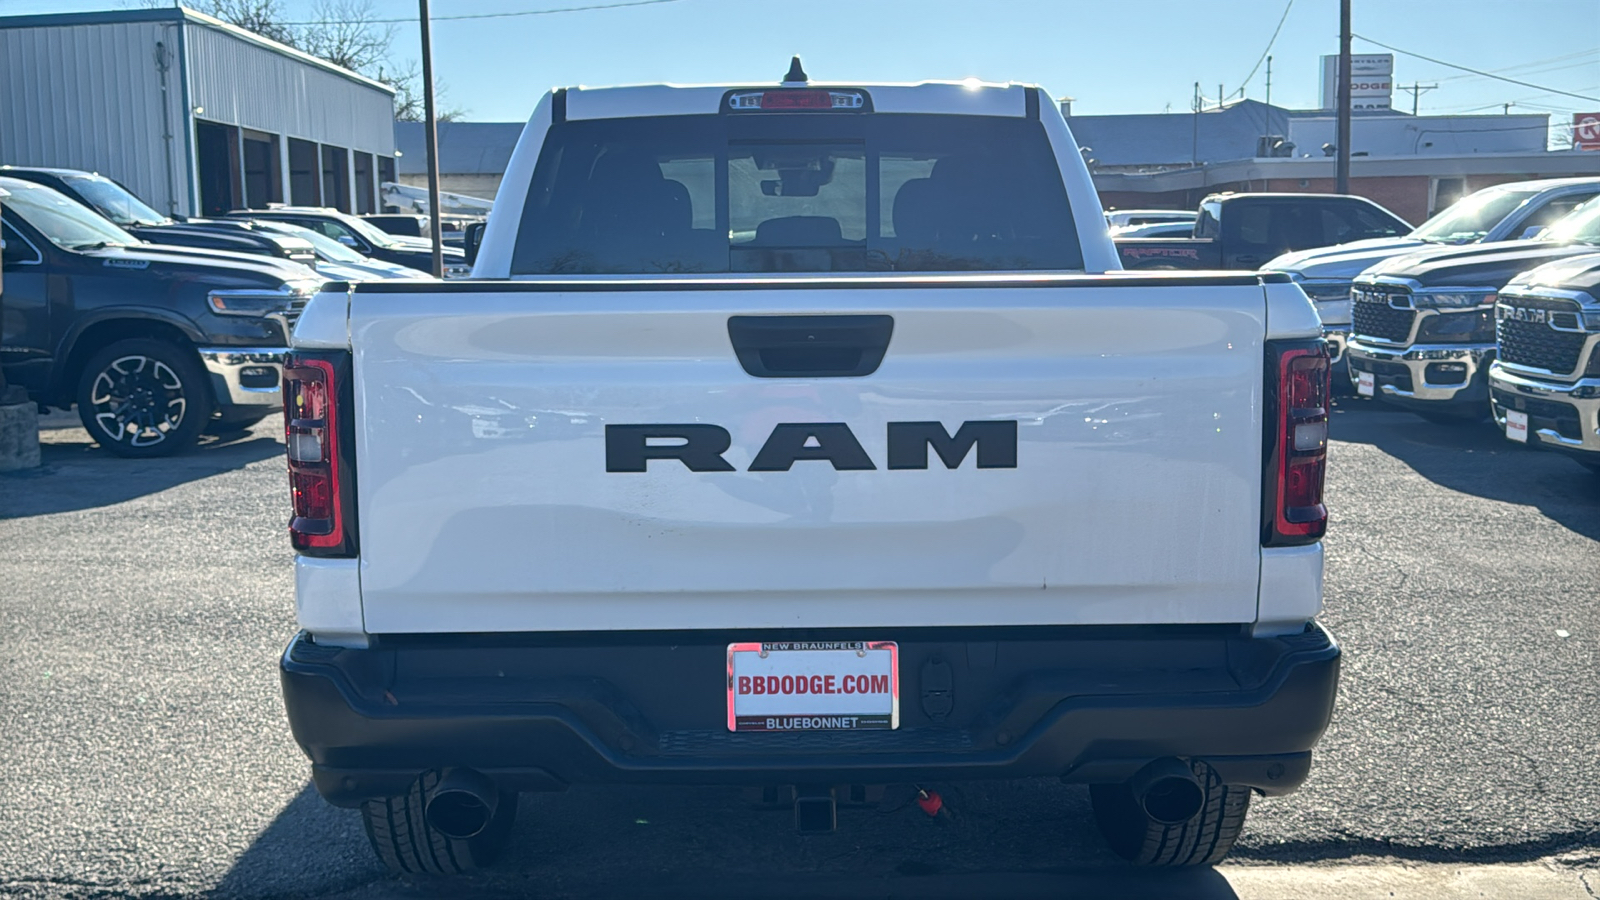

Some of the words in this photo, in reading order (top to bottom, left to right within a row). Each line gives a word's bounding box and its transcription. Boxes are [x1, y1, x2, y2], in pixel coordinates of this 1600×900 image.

[1350, 82, 1390, 90] ODGE
[1123, 248, 1200, 260] RAPTOR
[1356, 291, 1387, 304] RAM
[1503, 306, 1546, 324] RAM
[605, 420, 1018, 473] RAM
[793, 642, 862, 650] BRAUNFELS
[738, 675, 889, 695] BBDODGE.COM
[766, 717, 859, 729] BLUEBONNET
